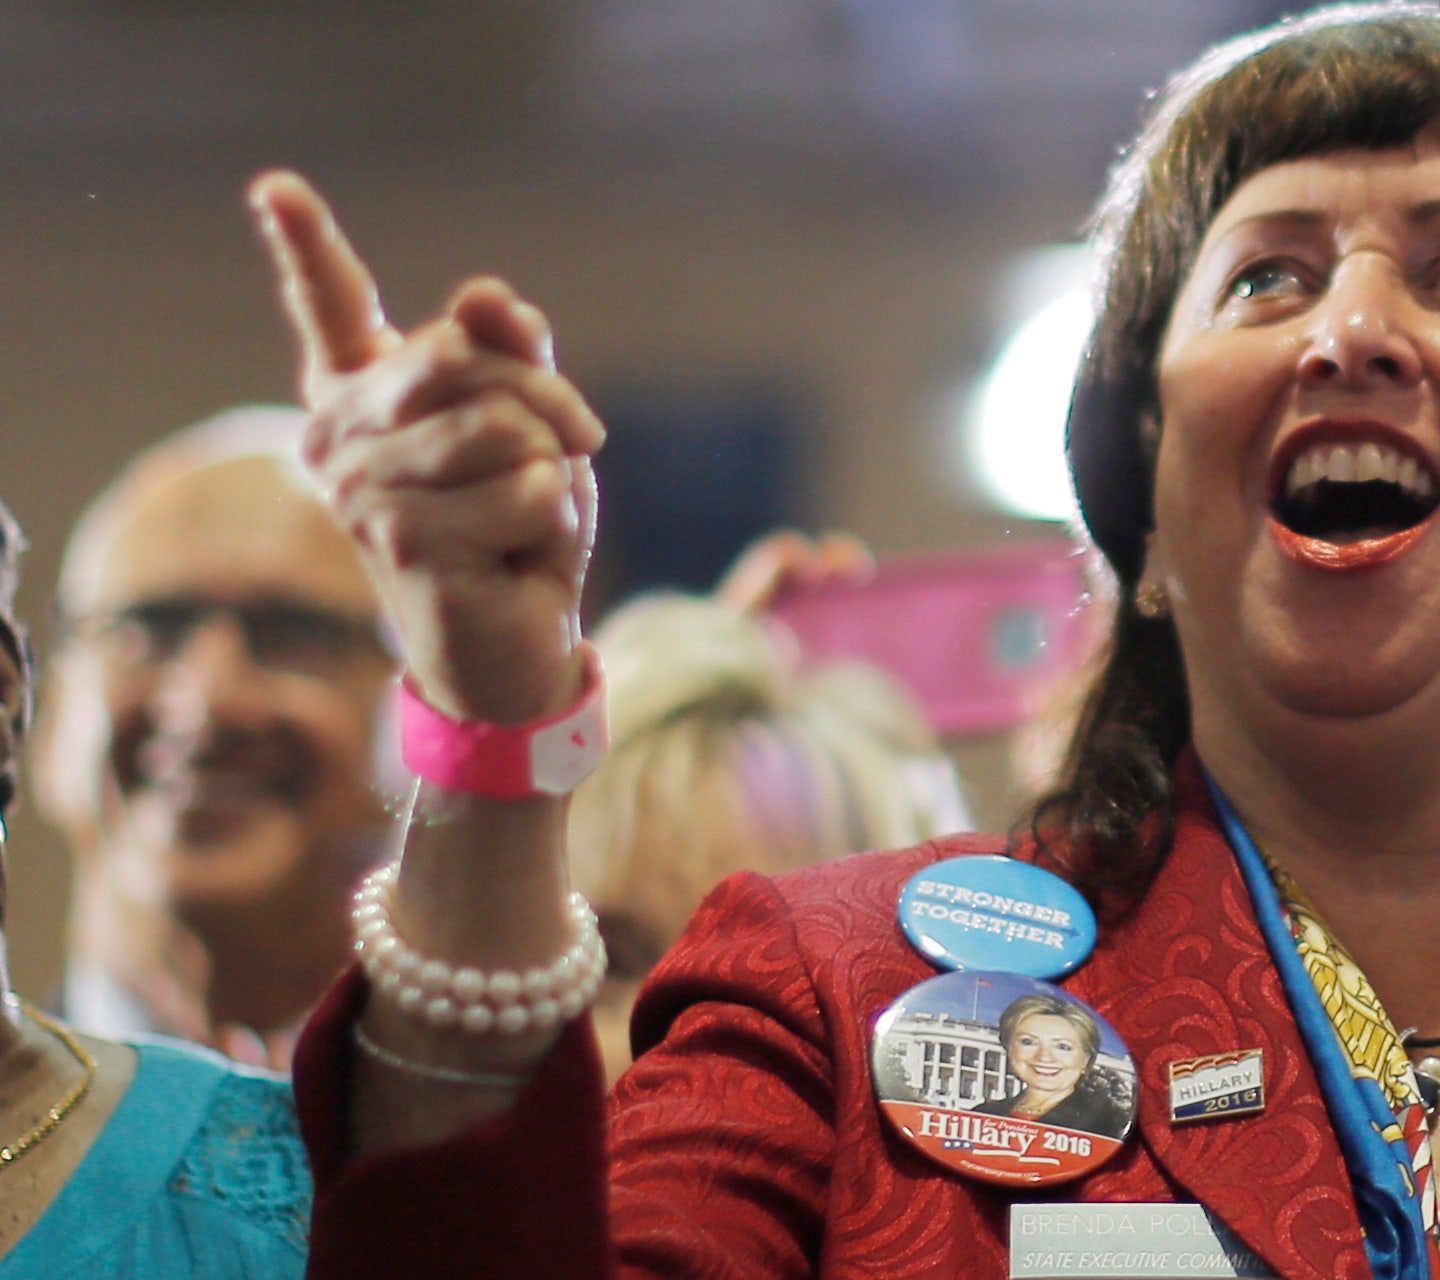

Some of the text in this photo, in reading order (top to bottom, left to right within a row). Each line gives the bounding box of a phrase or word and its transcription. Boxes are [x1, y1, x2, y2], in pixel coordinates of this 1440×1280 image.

[915, 880, 1071, 927] STRONGER
[911, 901, 1065, 949] TOGETHER
[1179, 1071, 1252, 1100] HILLARY
[1204, 1089, 1257, 1112] 2016
[919, 1111, 1092, 1157] Hillary 2016
[1021, 1213, 1229, 1236] BRENDA POLL
[1023, 1252, 1074, 1269] STATE
[1078, 1252, 1172, 1269] EXECUTIVE
